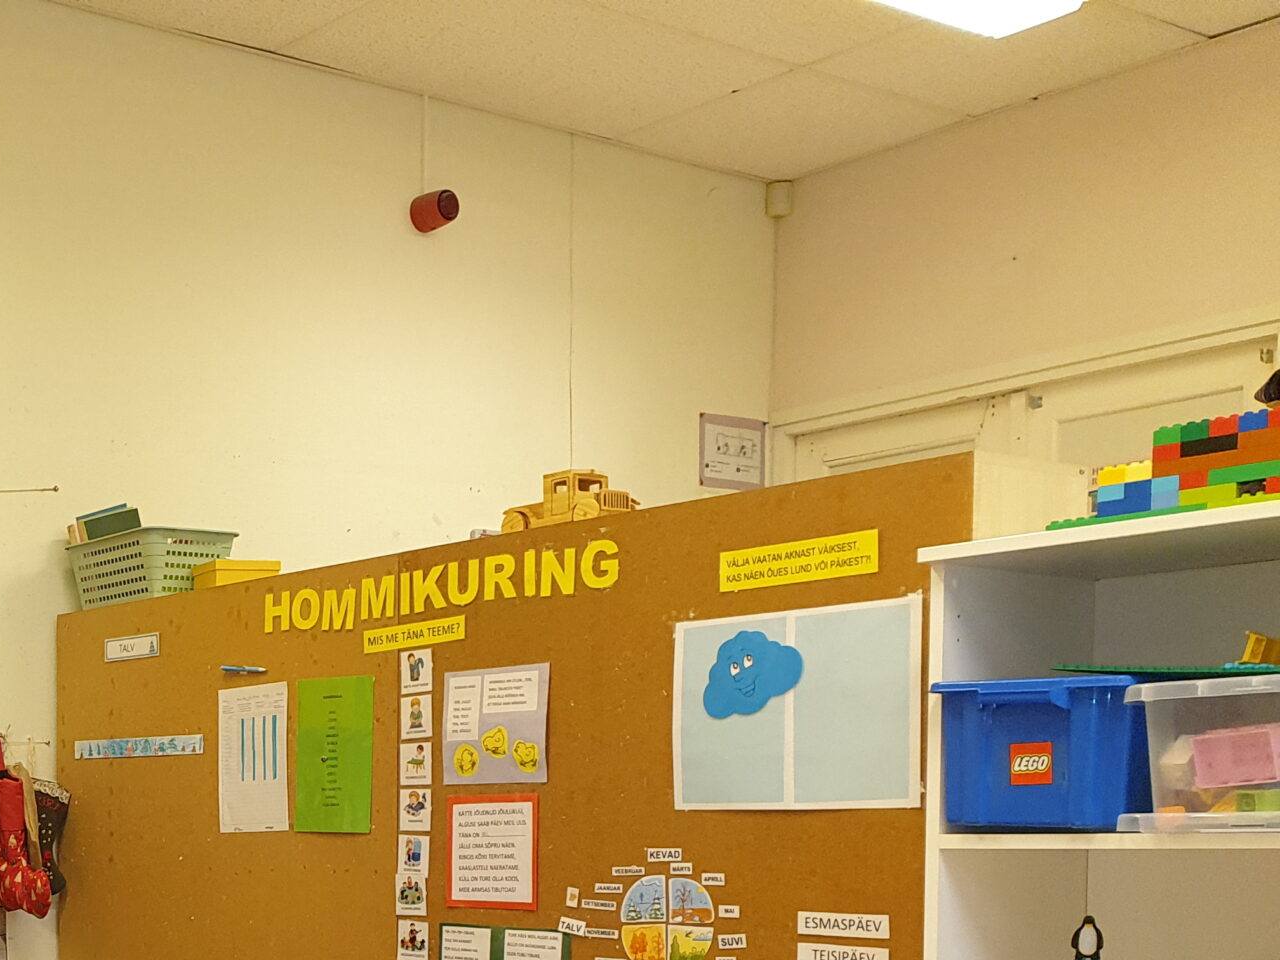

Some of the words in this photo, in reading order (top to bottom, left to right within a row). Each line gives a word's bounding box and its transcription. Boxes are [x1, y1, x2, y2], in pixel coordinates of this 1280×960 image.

[726, 556, 750, 568] VÄLJA
[751, 551, 783, 565] VAATAN
[784, 547, 816, 560] AKNAST
[726, 573, 742, 583] KAS
[743, 568, 765, 580] NÄEN
[790, 563, 812, 575] LUND
[264, 539, 619, 634] HOMMIKURING
[368, 635, 384, 646] MIS
[386, 633, 399, 643] ME
[401, 629, 425, 642] TÄNA
[427, 622, 460, 637] TEEME?
[119, 642, 135, 653] TALV
[1013, 755, 1049, 771] LEGO
[649, 850, 680, 859] KEVAD
[560, 922, 582, 932] TALV
[804, 916, 882, 932] ESMASPÄEV
[586, 929, 616, 937] NOVEMBER
[720, 937, 743, 946] SUVI
